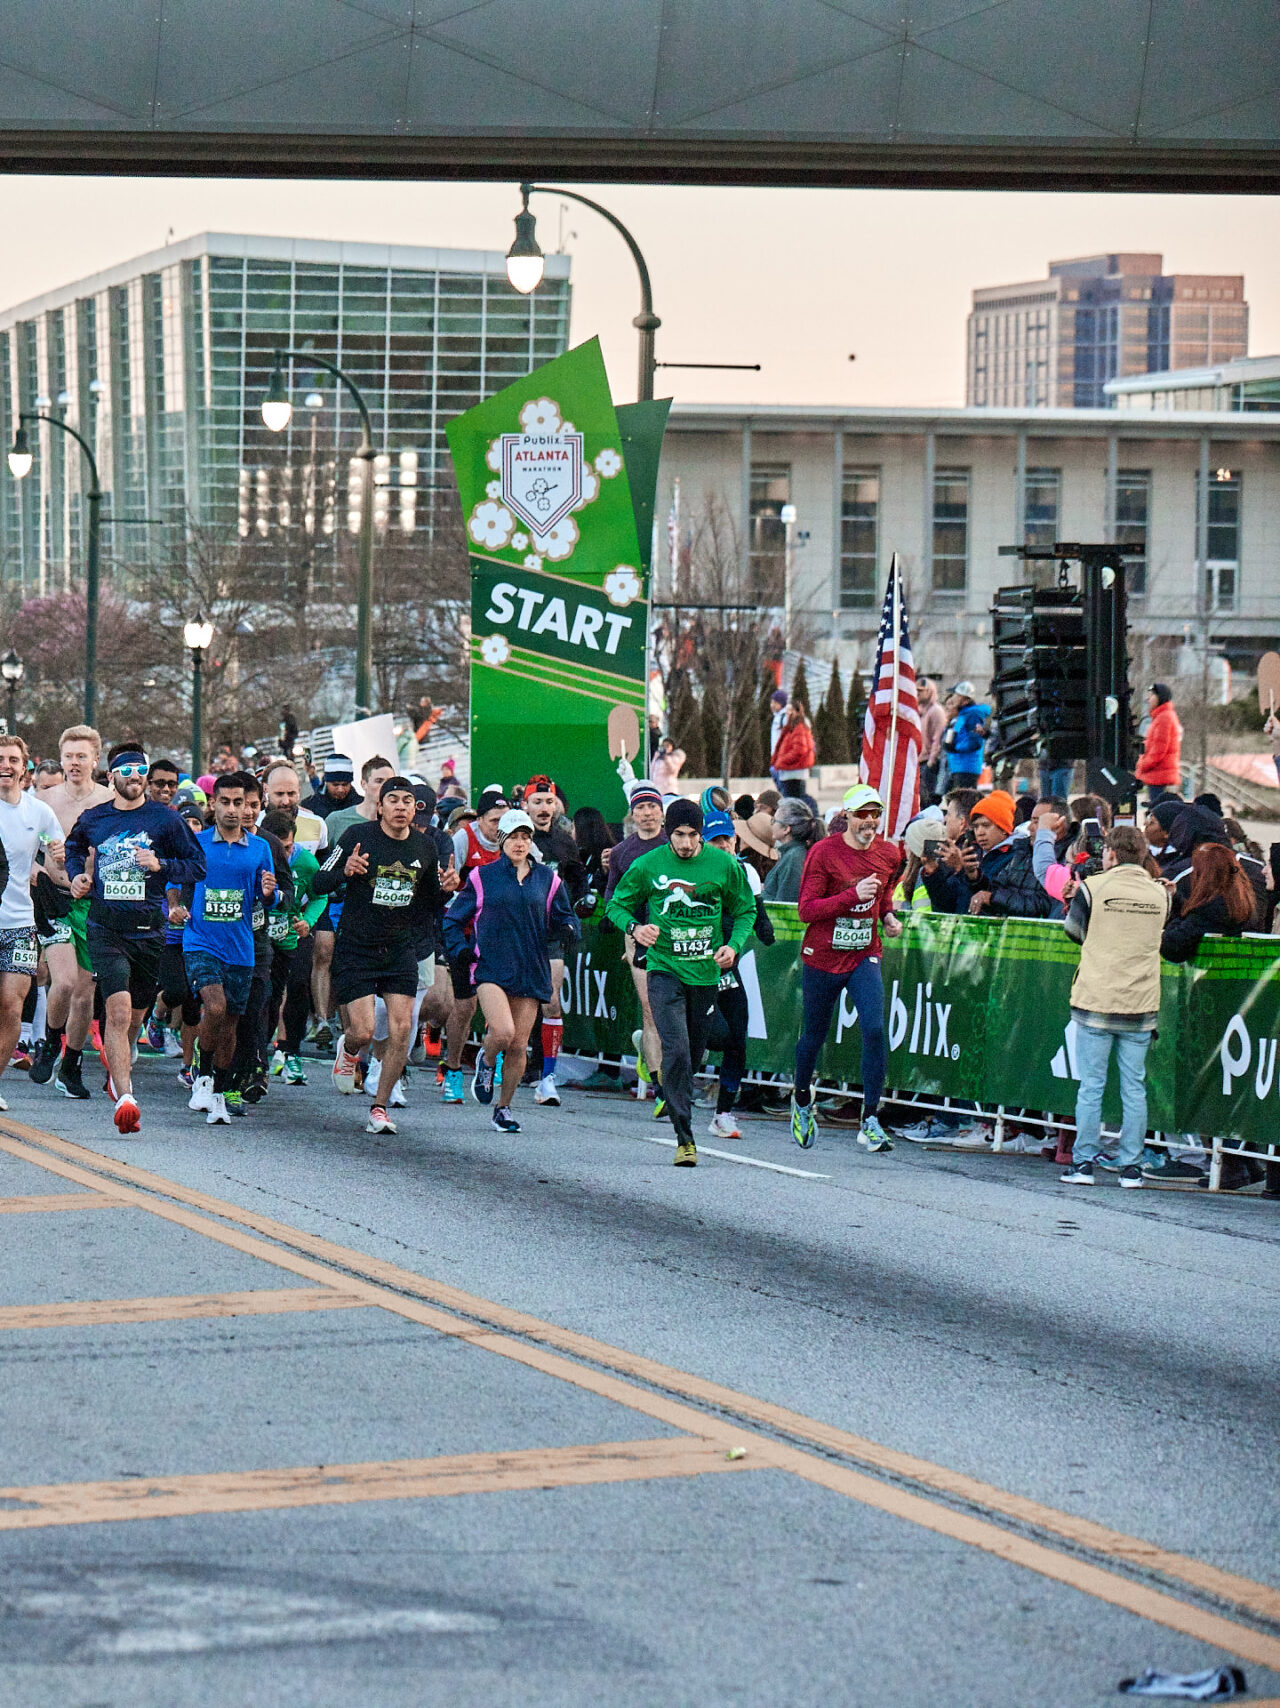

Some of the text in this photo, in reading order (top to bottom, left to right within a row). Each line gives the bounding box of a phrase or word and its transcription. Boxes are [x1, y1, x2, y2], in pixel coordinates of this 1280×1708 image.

[523, 435, 560, 445] Publix
[514, 450, 569, 461] ATLANTA
[485, 582, 633, 655] START
[105, 884, 143, 895] B6061
[205, 902, 241, 914] B1359
[834, 930, 870, 942] B6044
[673, 939, 711, 952] B1437
